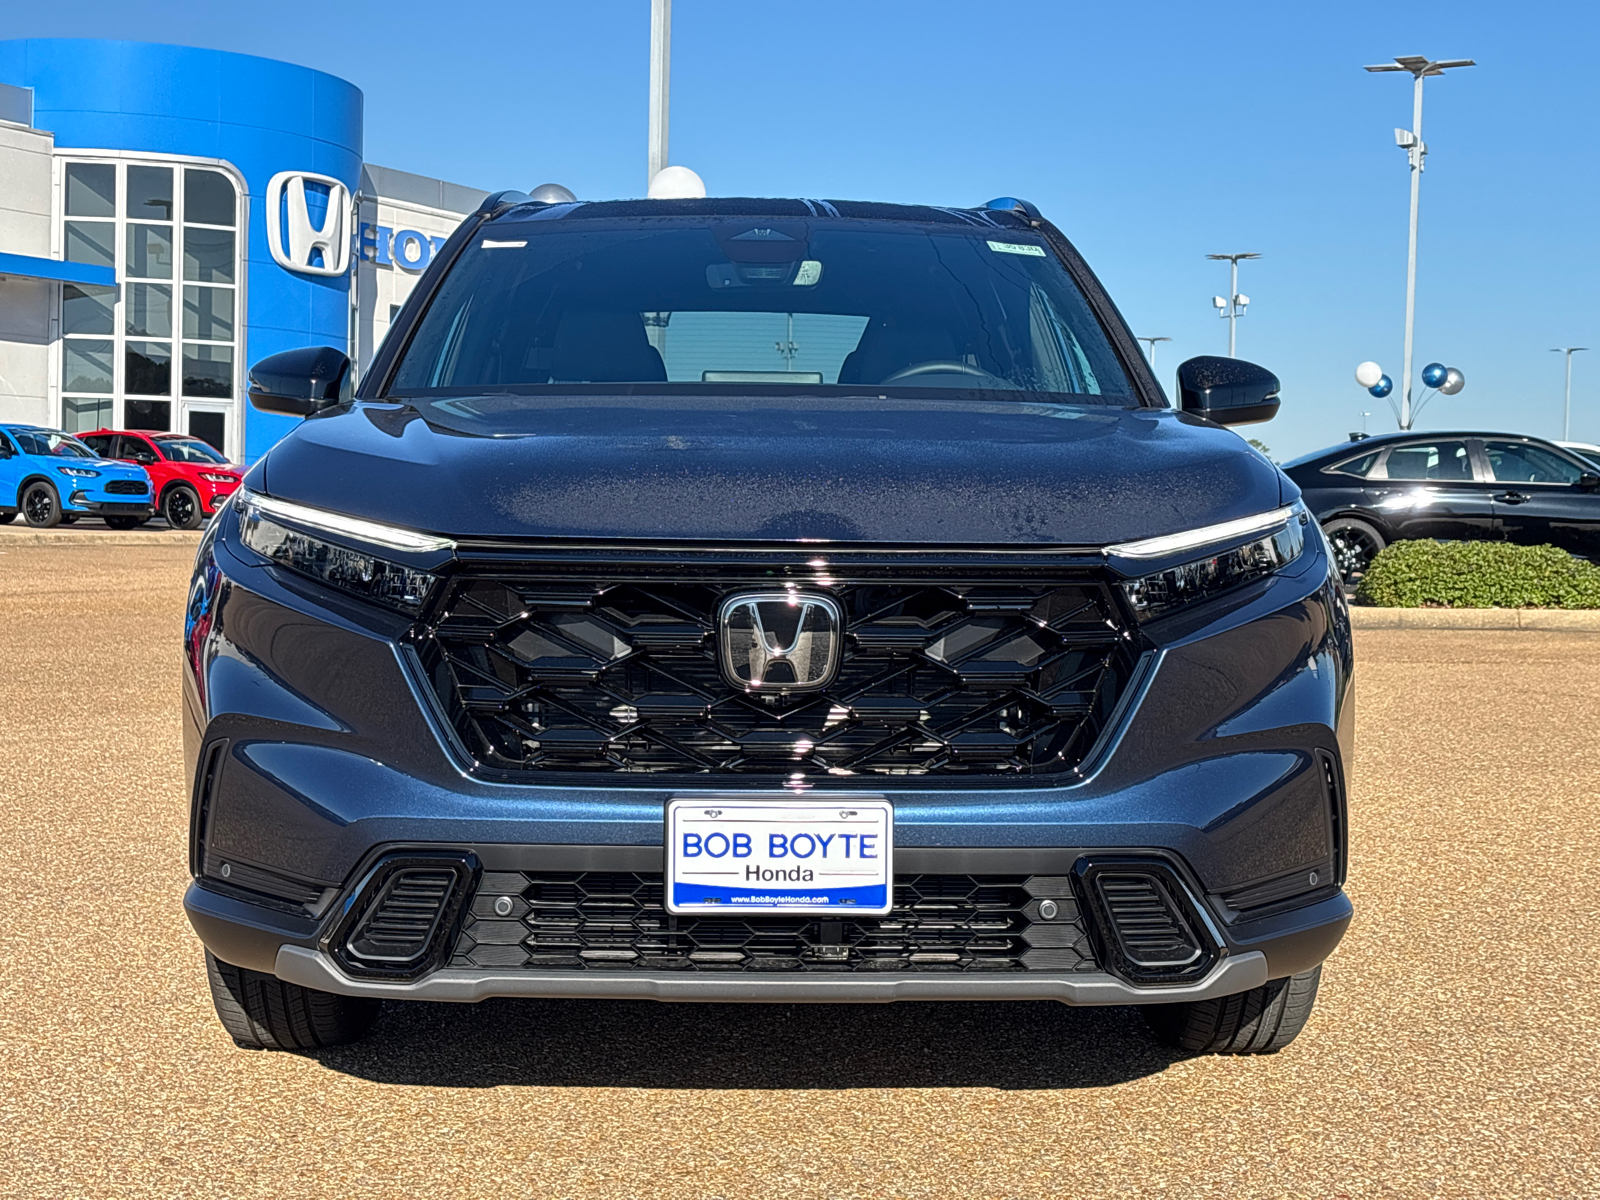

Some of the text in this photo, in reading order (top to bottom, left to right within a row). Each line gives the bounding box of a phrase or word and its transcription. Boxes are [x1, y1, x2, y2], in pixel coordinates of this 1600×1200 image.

[360, 221, 447, 270] HO
[682, 832, 878, 859] BOB BOYTE
[745, 865, 814, 881] Honda
